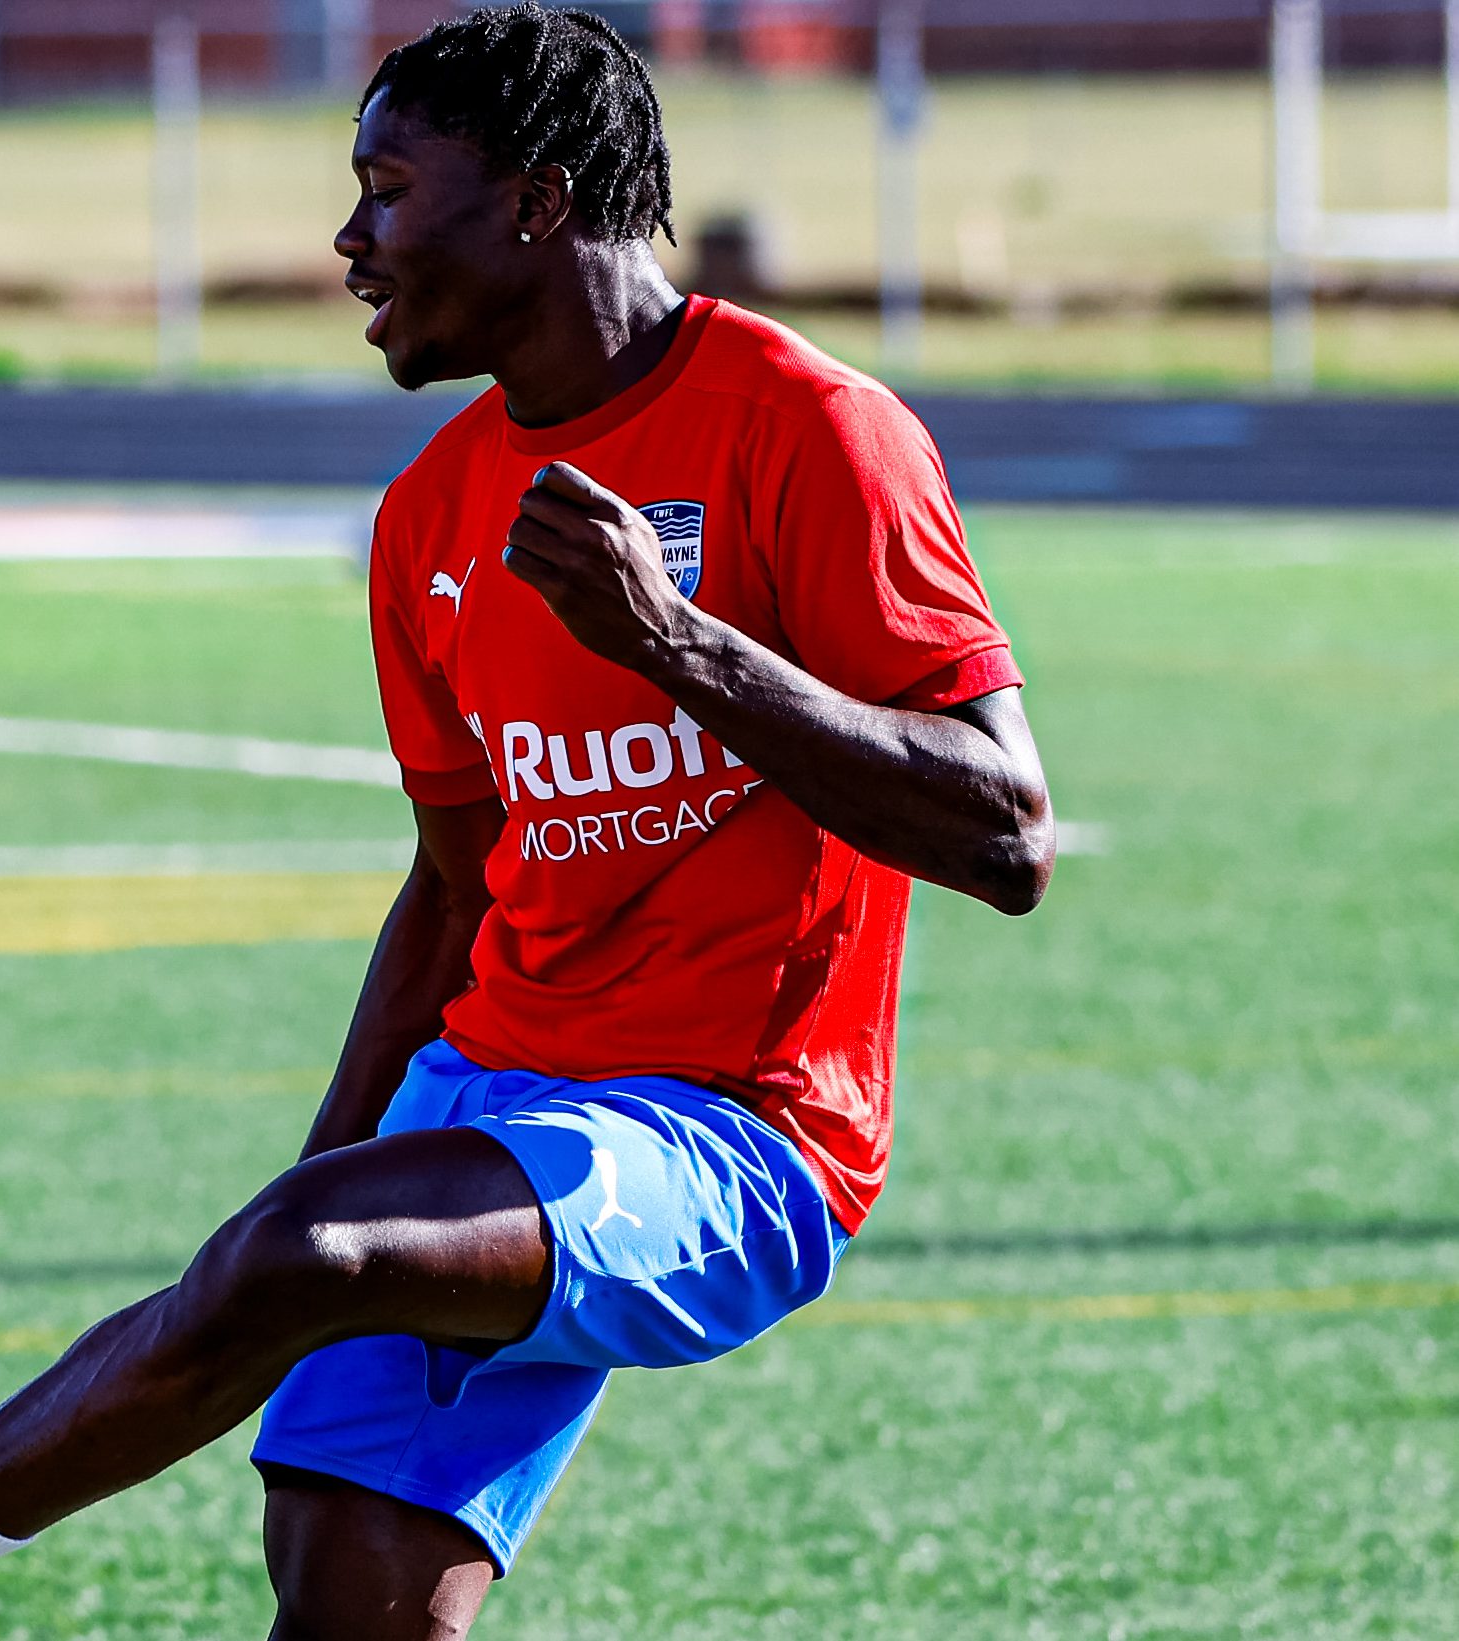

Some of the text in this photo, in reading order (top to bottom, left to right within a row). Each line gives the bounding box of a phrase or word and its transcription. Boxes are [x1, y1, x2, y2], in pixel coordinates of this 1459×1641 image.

[654, 508, 674, 519] FWFC
[502, 705, 744, 801] Ruof
[520, 779, 764, 860] MORTGAG
